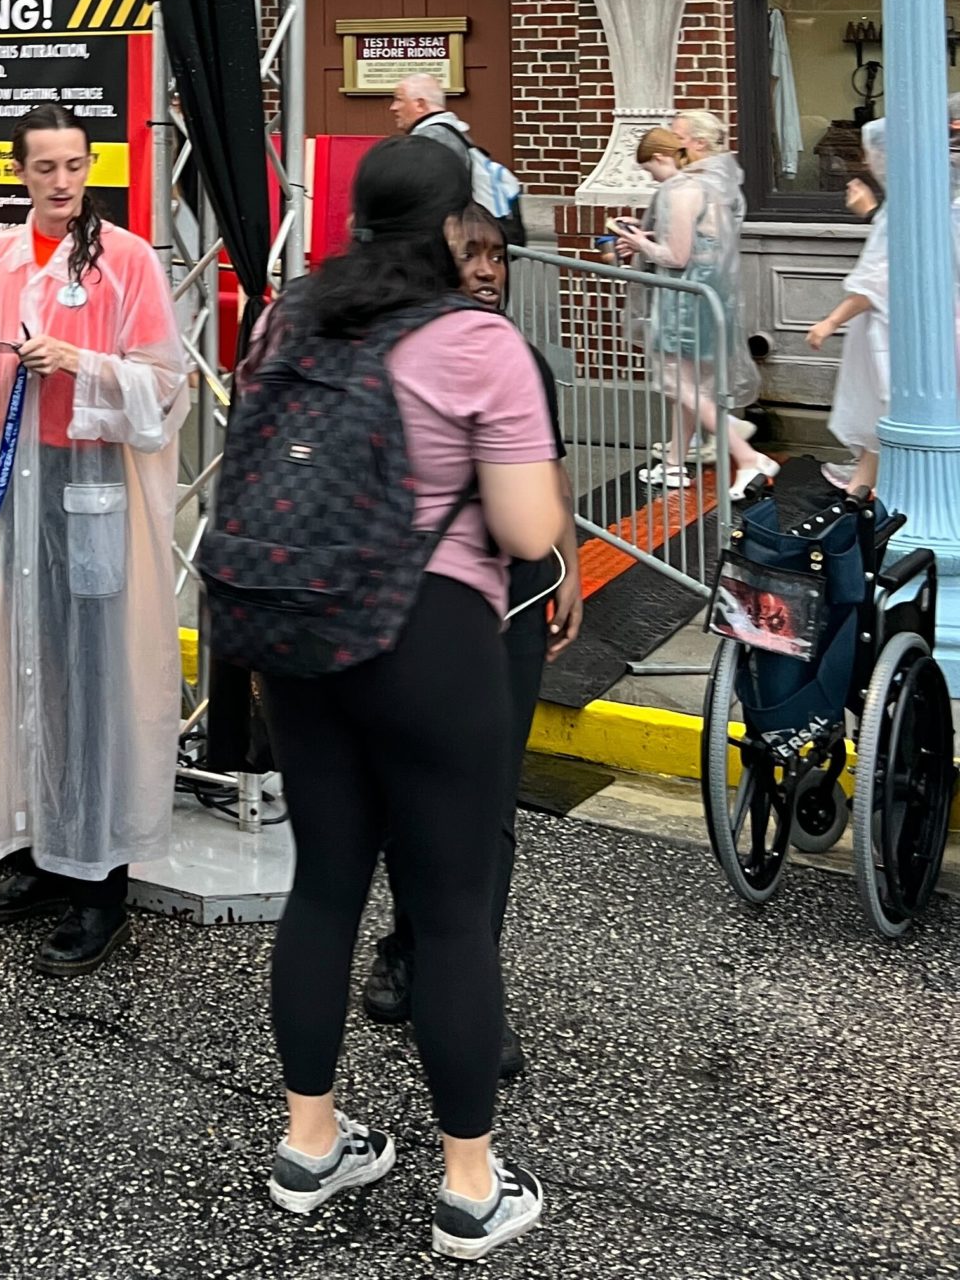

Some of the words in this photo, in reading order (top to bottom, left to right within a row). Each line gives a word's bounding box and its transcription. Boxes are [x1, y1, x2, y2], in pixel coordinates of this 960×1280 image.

[363, 37, 390, 48] TEST
[392, 37, 416, 48] THIS
[418, 36, 446, 47] SEAT
[363, 47, 405, 58] BEFORE
[407, 47, 446, 58] RIDING
[776, 715, 830, 758] ERSAL
